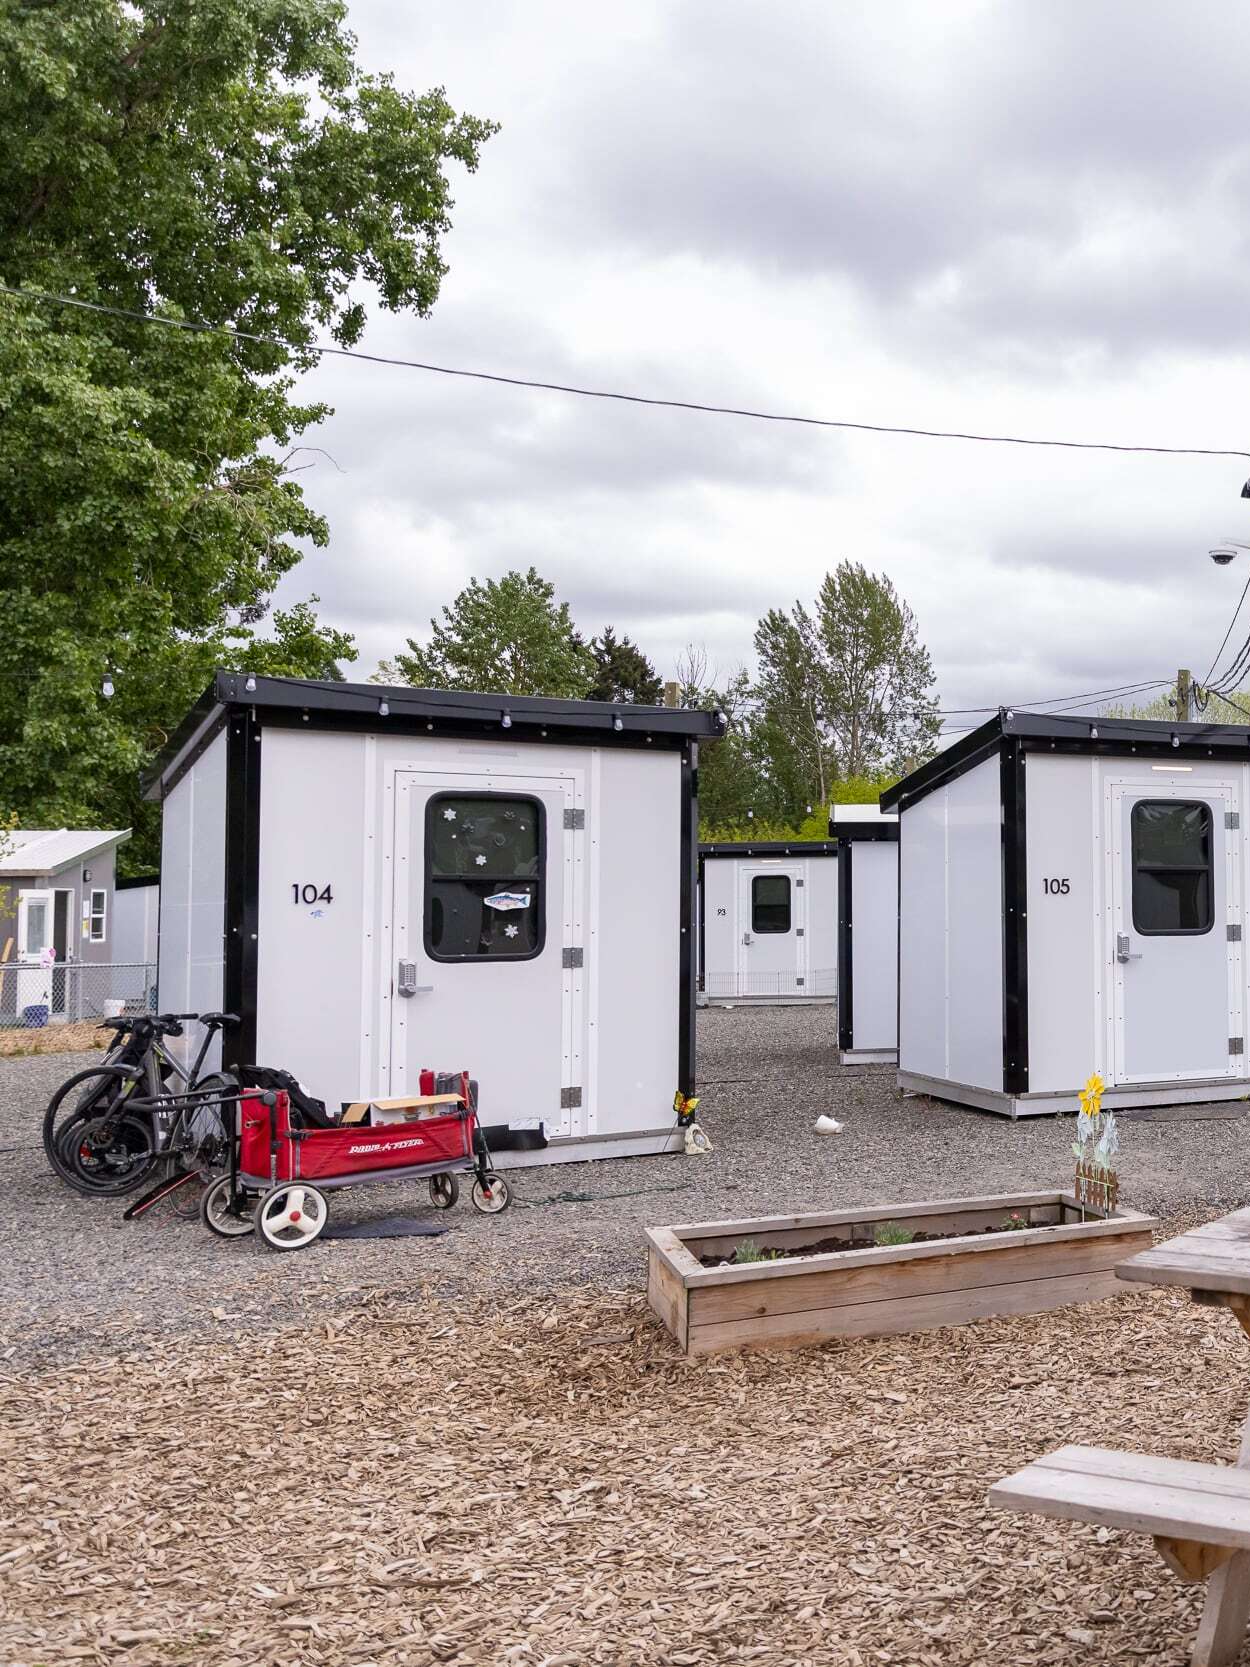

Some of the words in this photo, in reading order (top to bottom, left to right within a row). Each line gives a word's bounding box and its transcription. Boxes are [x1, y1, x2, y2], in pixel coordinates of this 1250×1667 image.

[292, 883, 334, 904] 104
[1043, 878, 1070, 895] 105
[717, 908, 726, 916] 93
